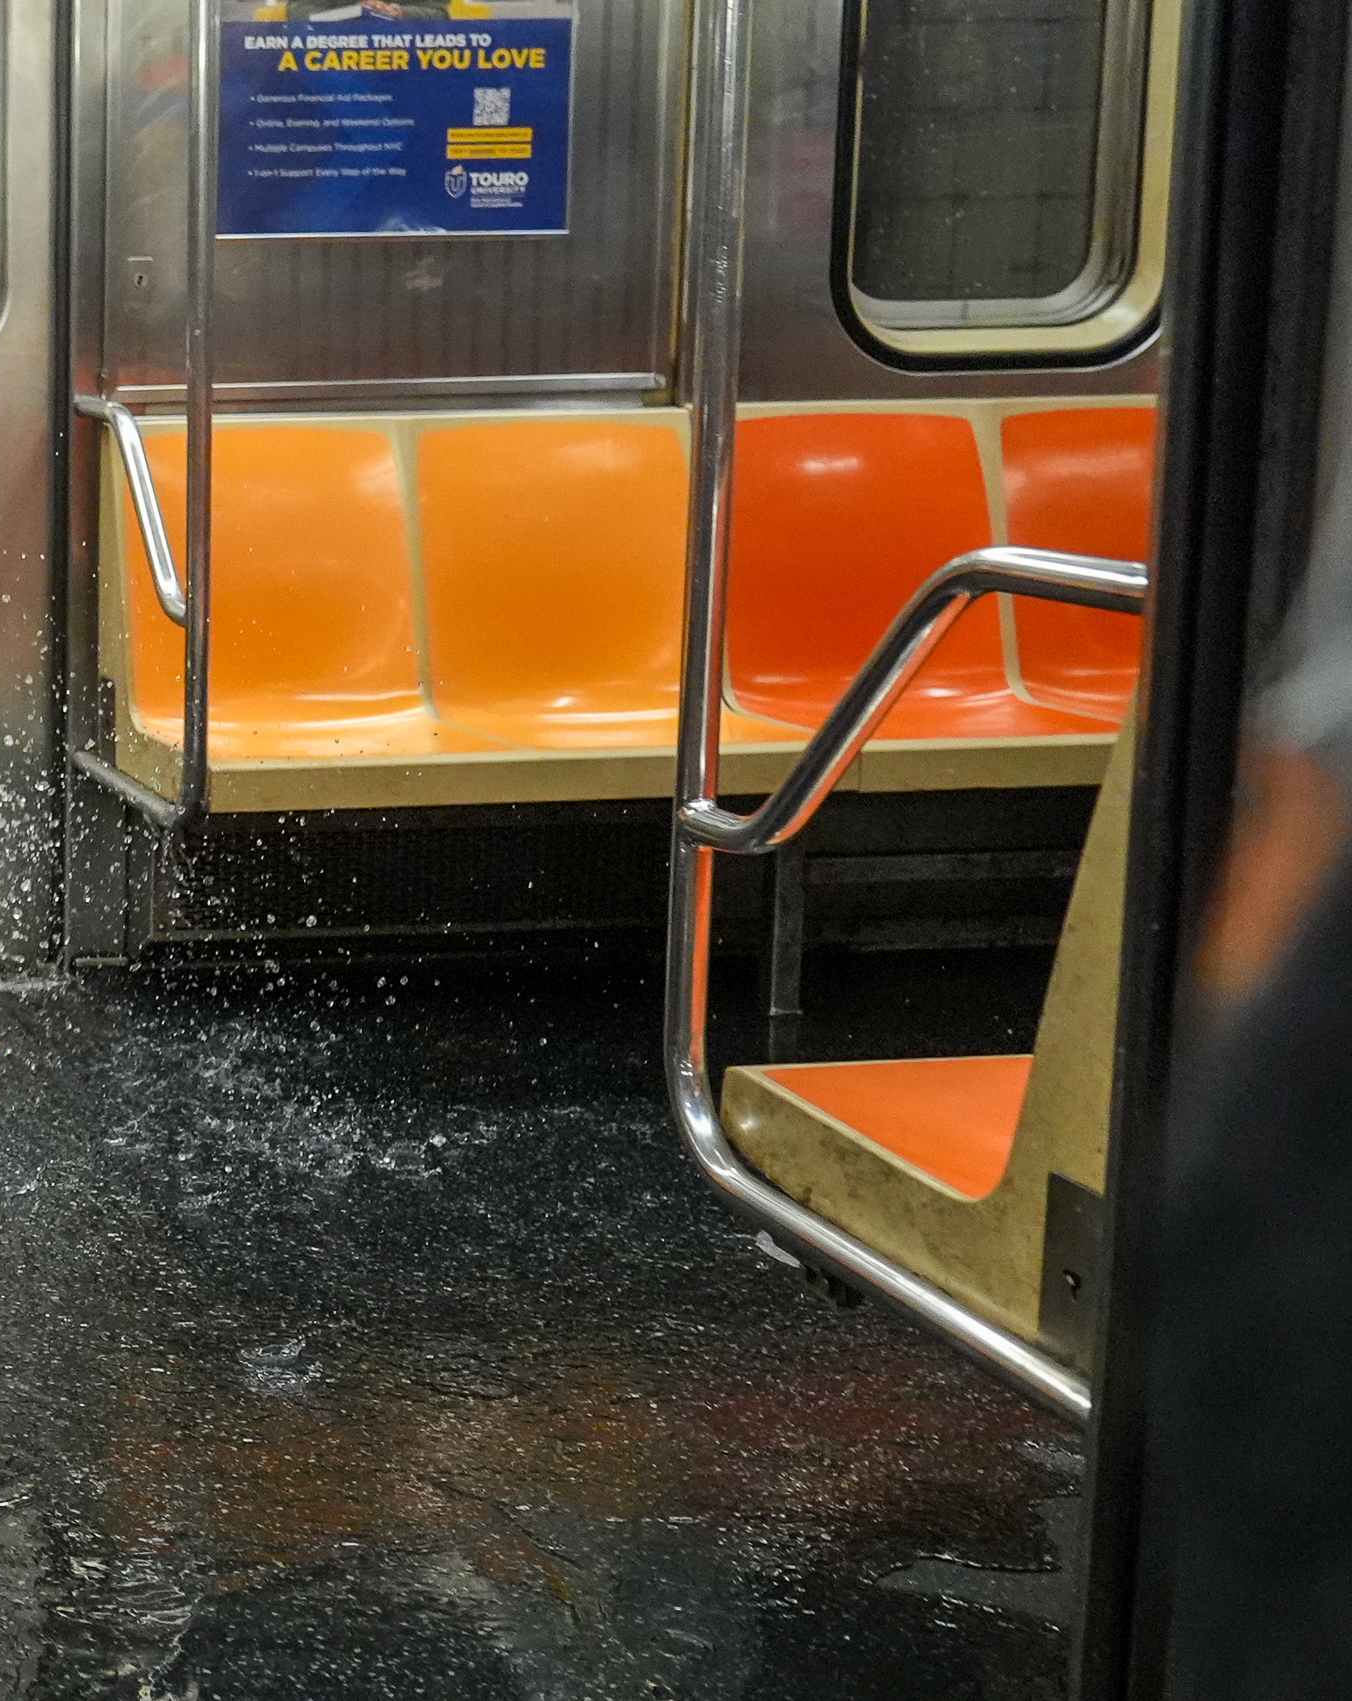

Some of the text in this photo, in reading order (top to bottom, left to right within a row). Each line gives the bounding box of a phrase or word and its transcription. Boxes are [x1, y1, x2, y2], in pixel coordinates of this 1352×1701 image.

[243, 33, 492, 49] EARN A DEGREE THAT LEADS TO
[277, 48, 546, 71] A CAREER YOU LOVE
[468, 171, 529, 188] TOURO
